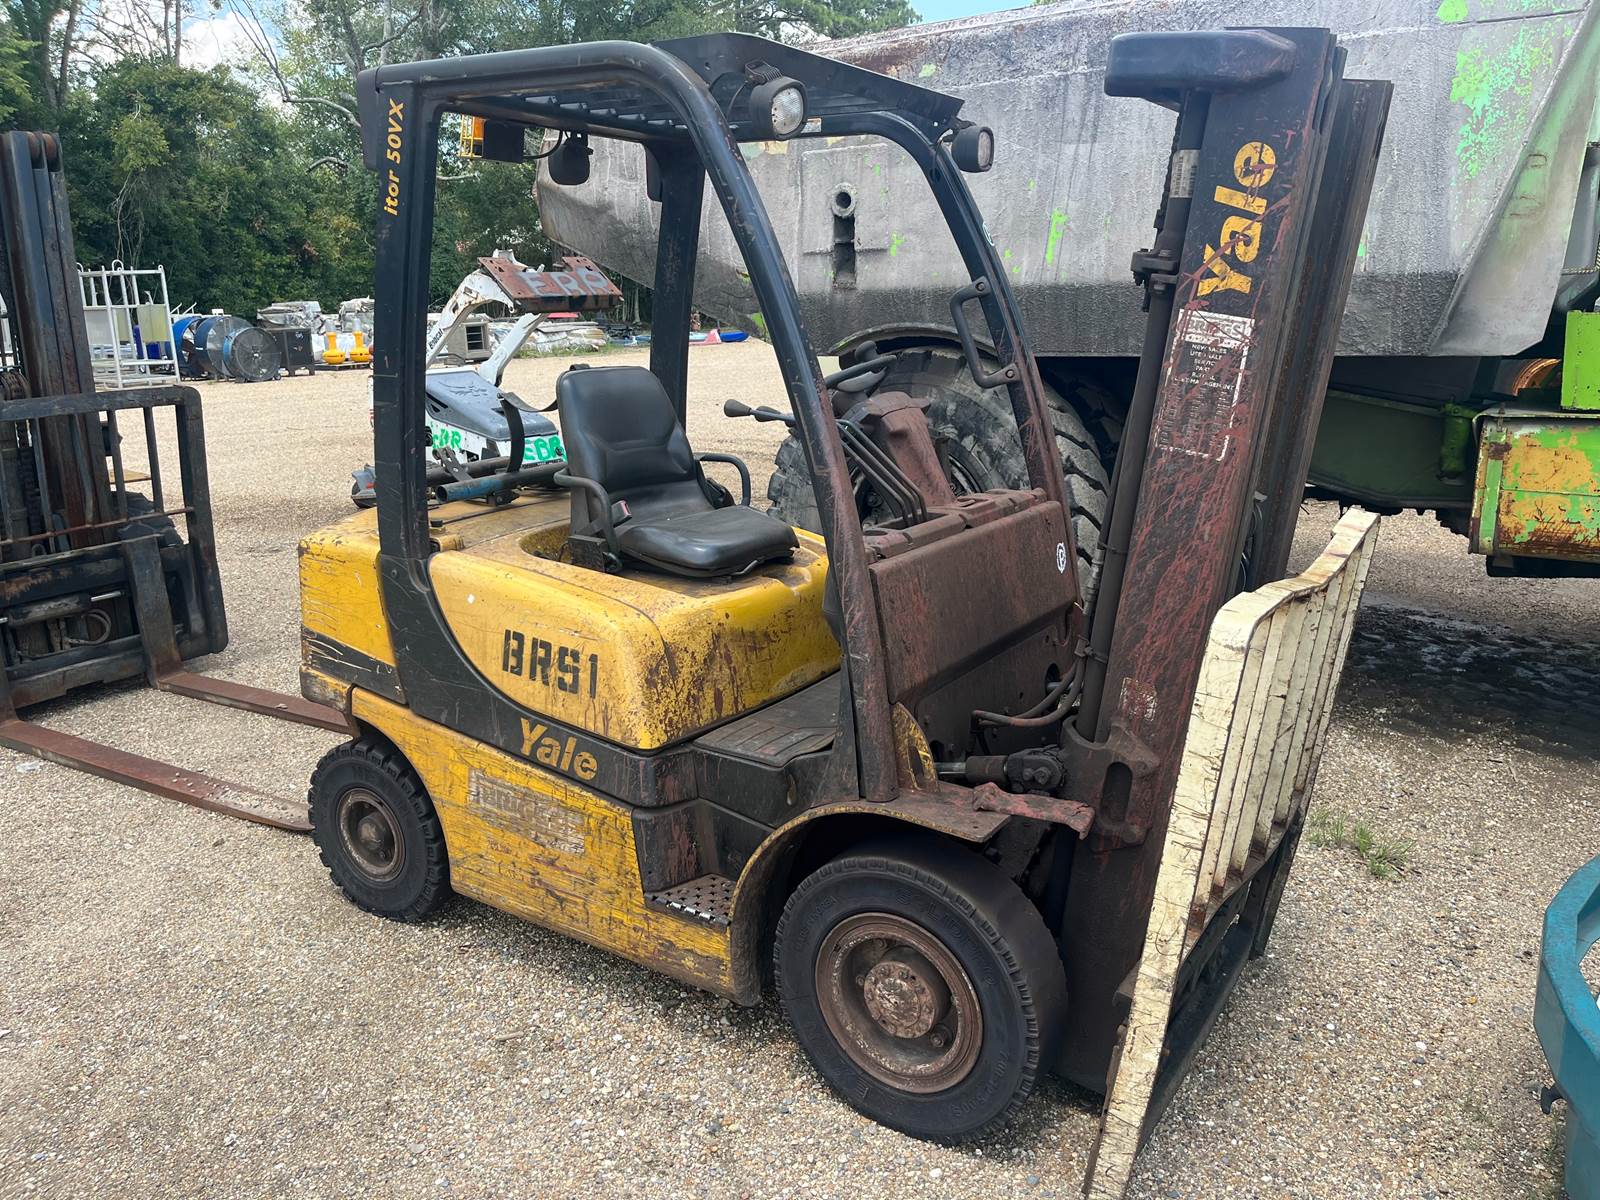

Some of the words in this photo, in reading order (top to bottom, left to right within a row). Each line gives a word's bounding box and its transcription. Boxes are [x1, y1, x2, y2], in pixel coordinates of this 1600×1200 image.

[386, 97, 405, 165] 50VX
[384, 169, 400, 216] itor
[1197, 141, 1277, 297] Yale
[502, 629, 599, 700] BRS1
[520, 717, 598, 781] Yale
